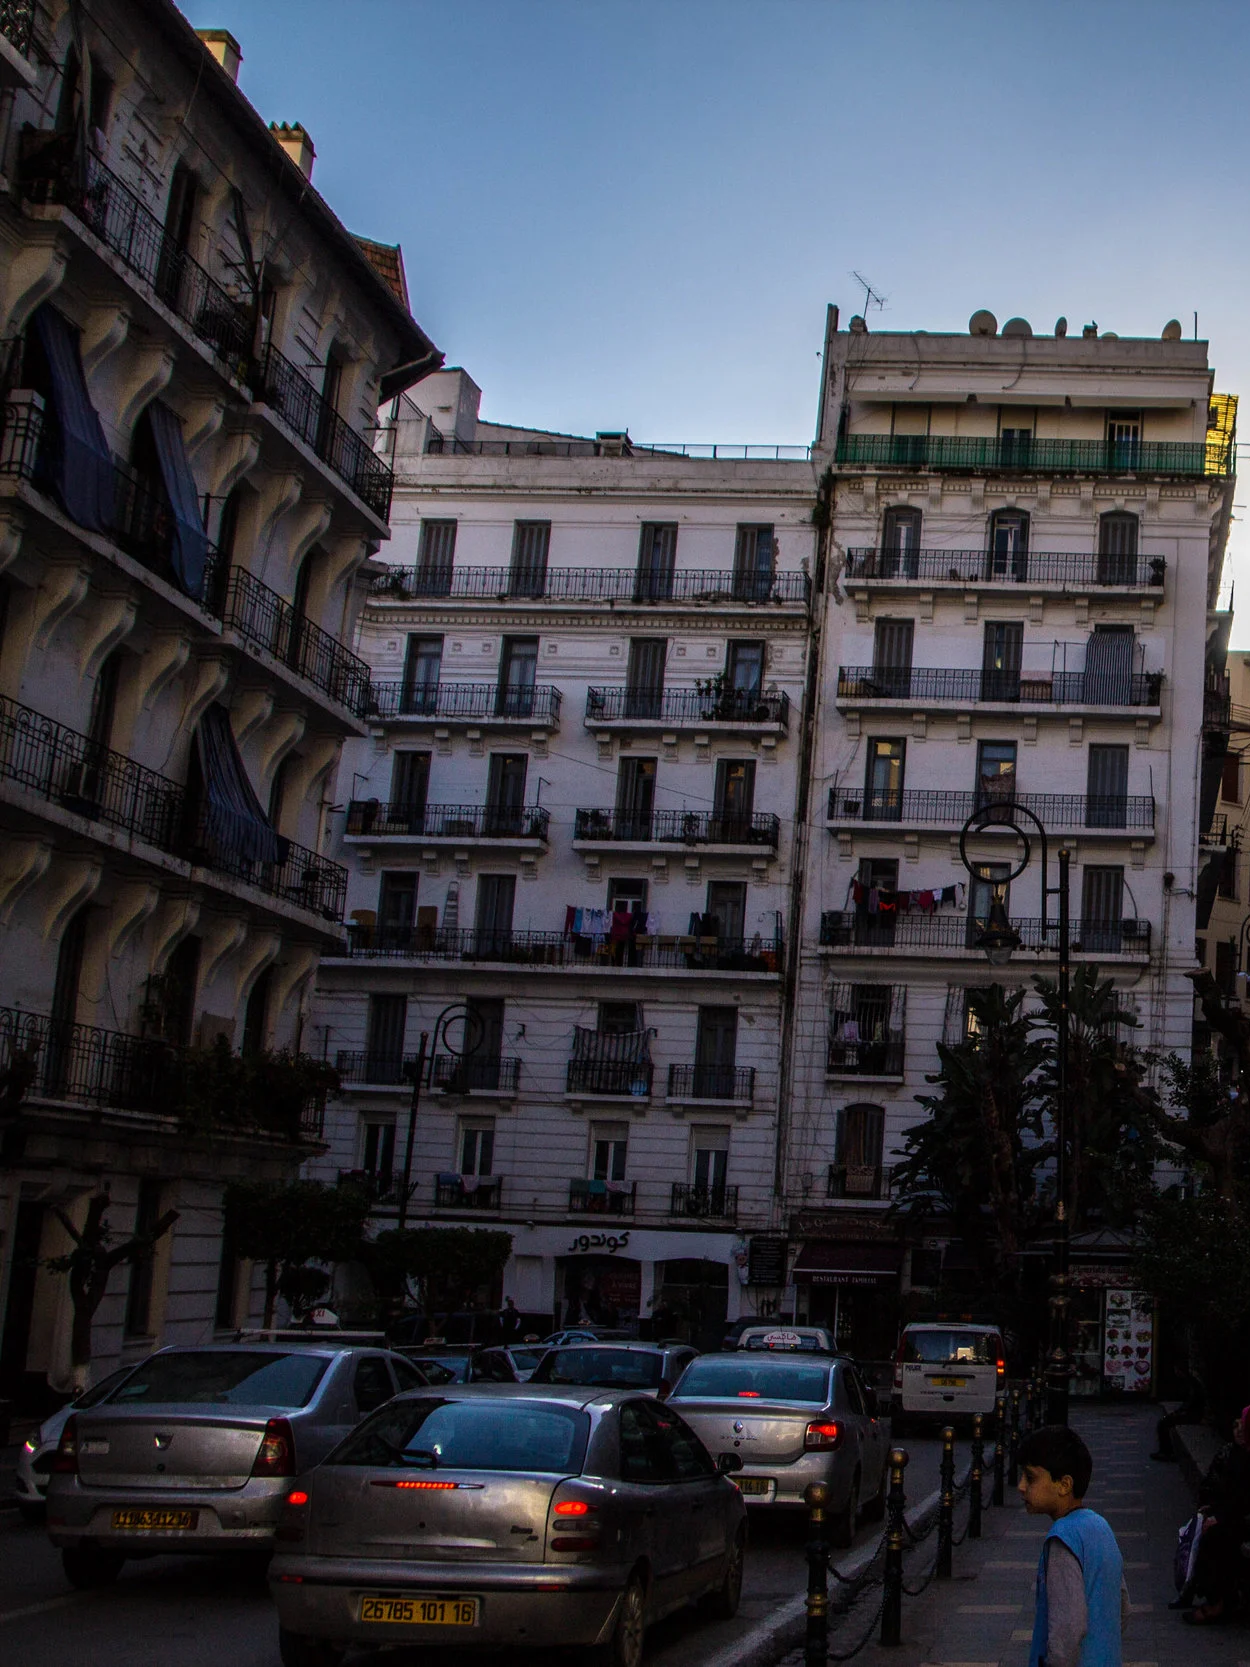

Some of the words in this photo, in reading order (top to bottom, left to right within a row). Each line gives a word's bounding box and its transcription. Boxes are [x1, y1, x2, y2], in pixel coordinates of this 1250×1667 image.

[568, 1231, 630, 1253] كوندور
[363, 1601, 413, 1621] 26785
[420, 1603, 445, 1621] 101
[455, 1604, 472, 1623] 16
